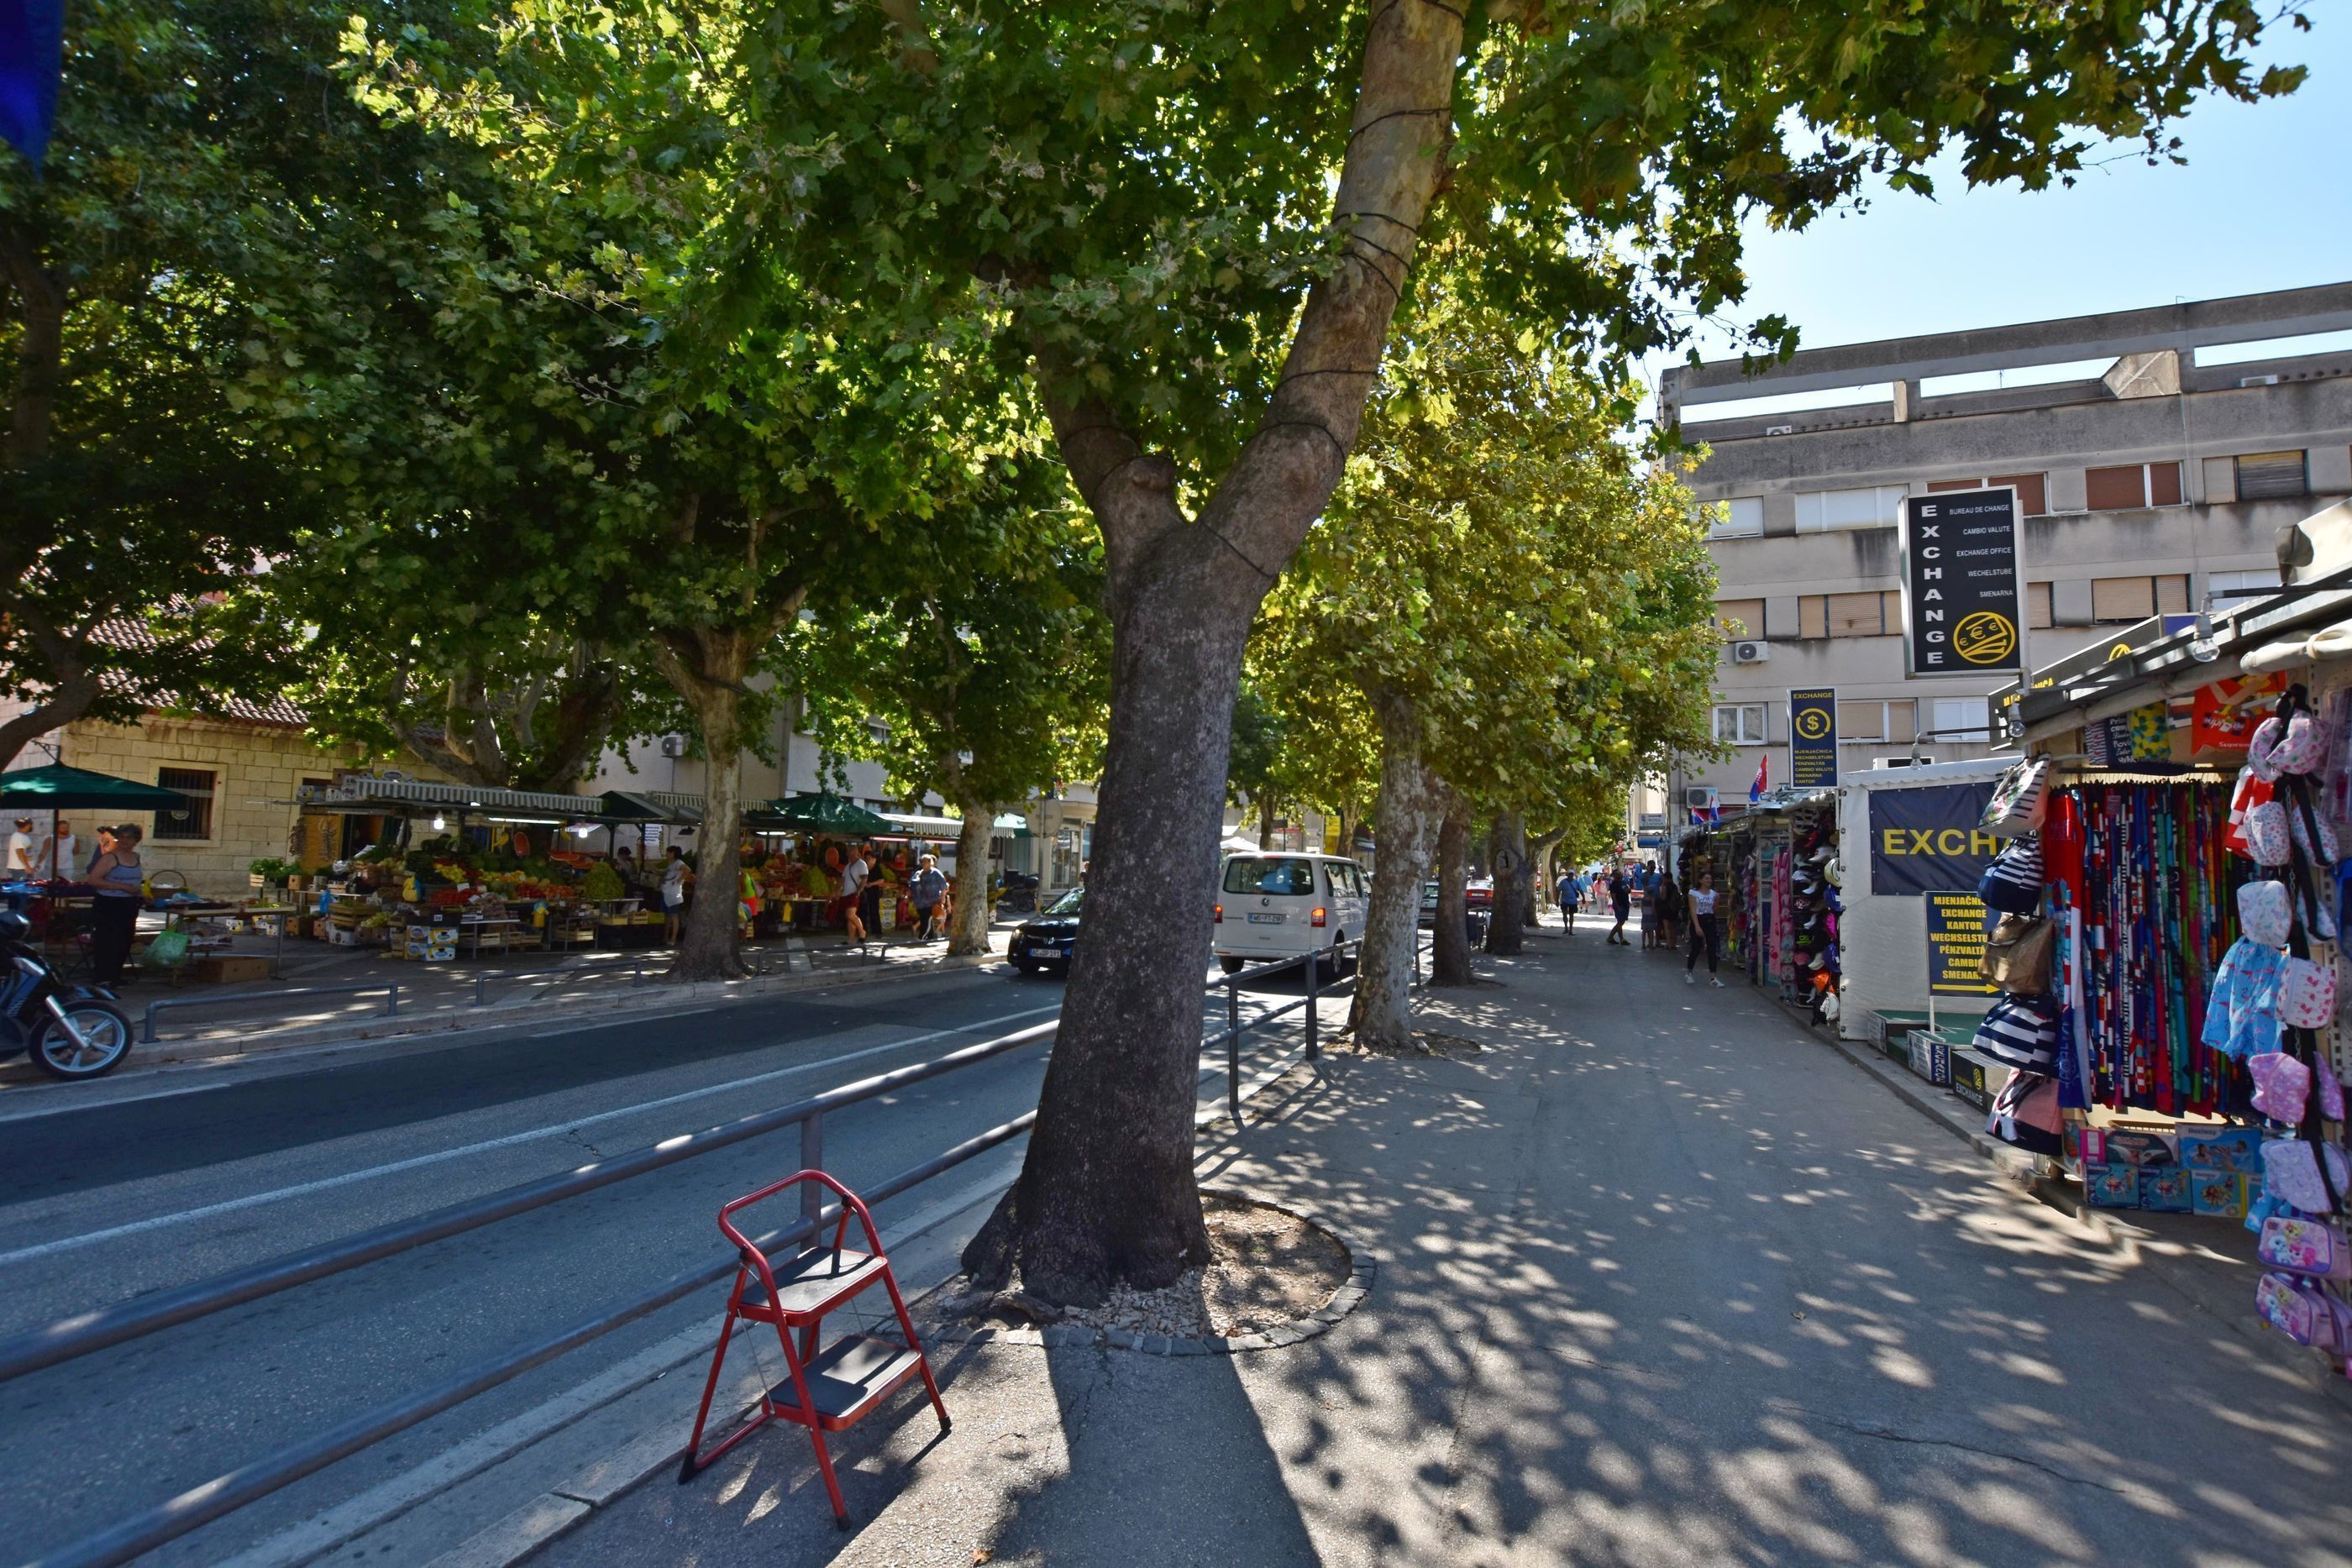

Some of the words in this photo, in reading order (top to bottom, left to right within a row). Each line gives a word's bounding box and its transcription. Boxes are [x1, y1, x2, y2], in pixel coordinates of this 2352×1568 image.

[1984, 504, 2009, 512] CHANGE
[1956, 548, 1989, 557] EXCHANGE
[1967, 569, 2013, 577] WECHELSTUBE
[1921, 505, 1945, 663] EXCHANGE
[1883, 829, 2013, 857] EXCH
[1934, 895, 1986, 905] MJENJAČNI
[1941, 909, 1987, 918] EXCHANGE
[1946, 921, 1982, 930] KANTOR
[1942, 970, 1982, 979] SMENAR
[1956, 1082, 1983, 1106] EXCHANGE
